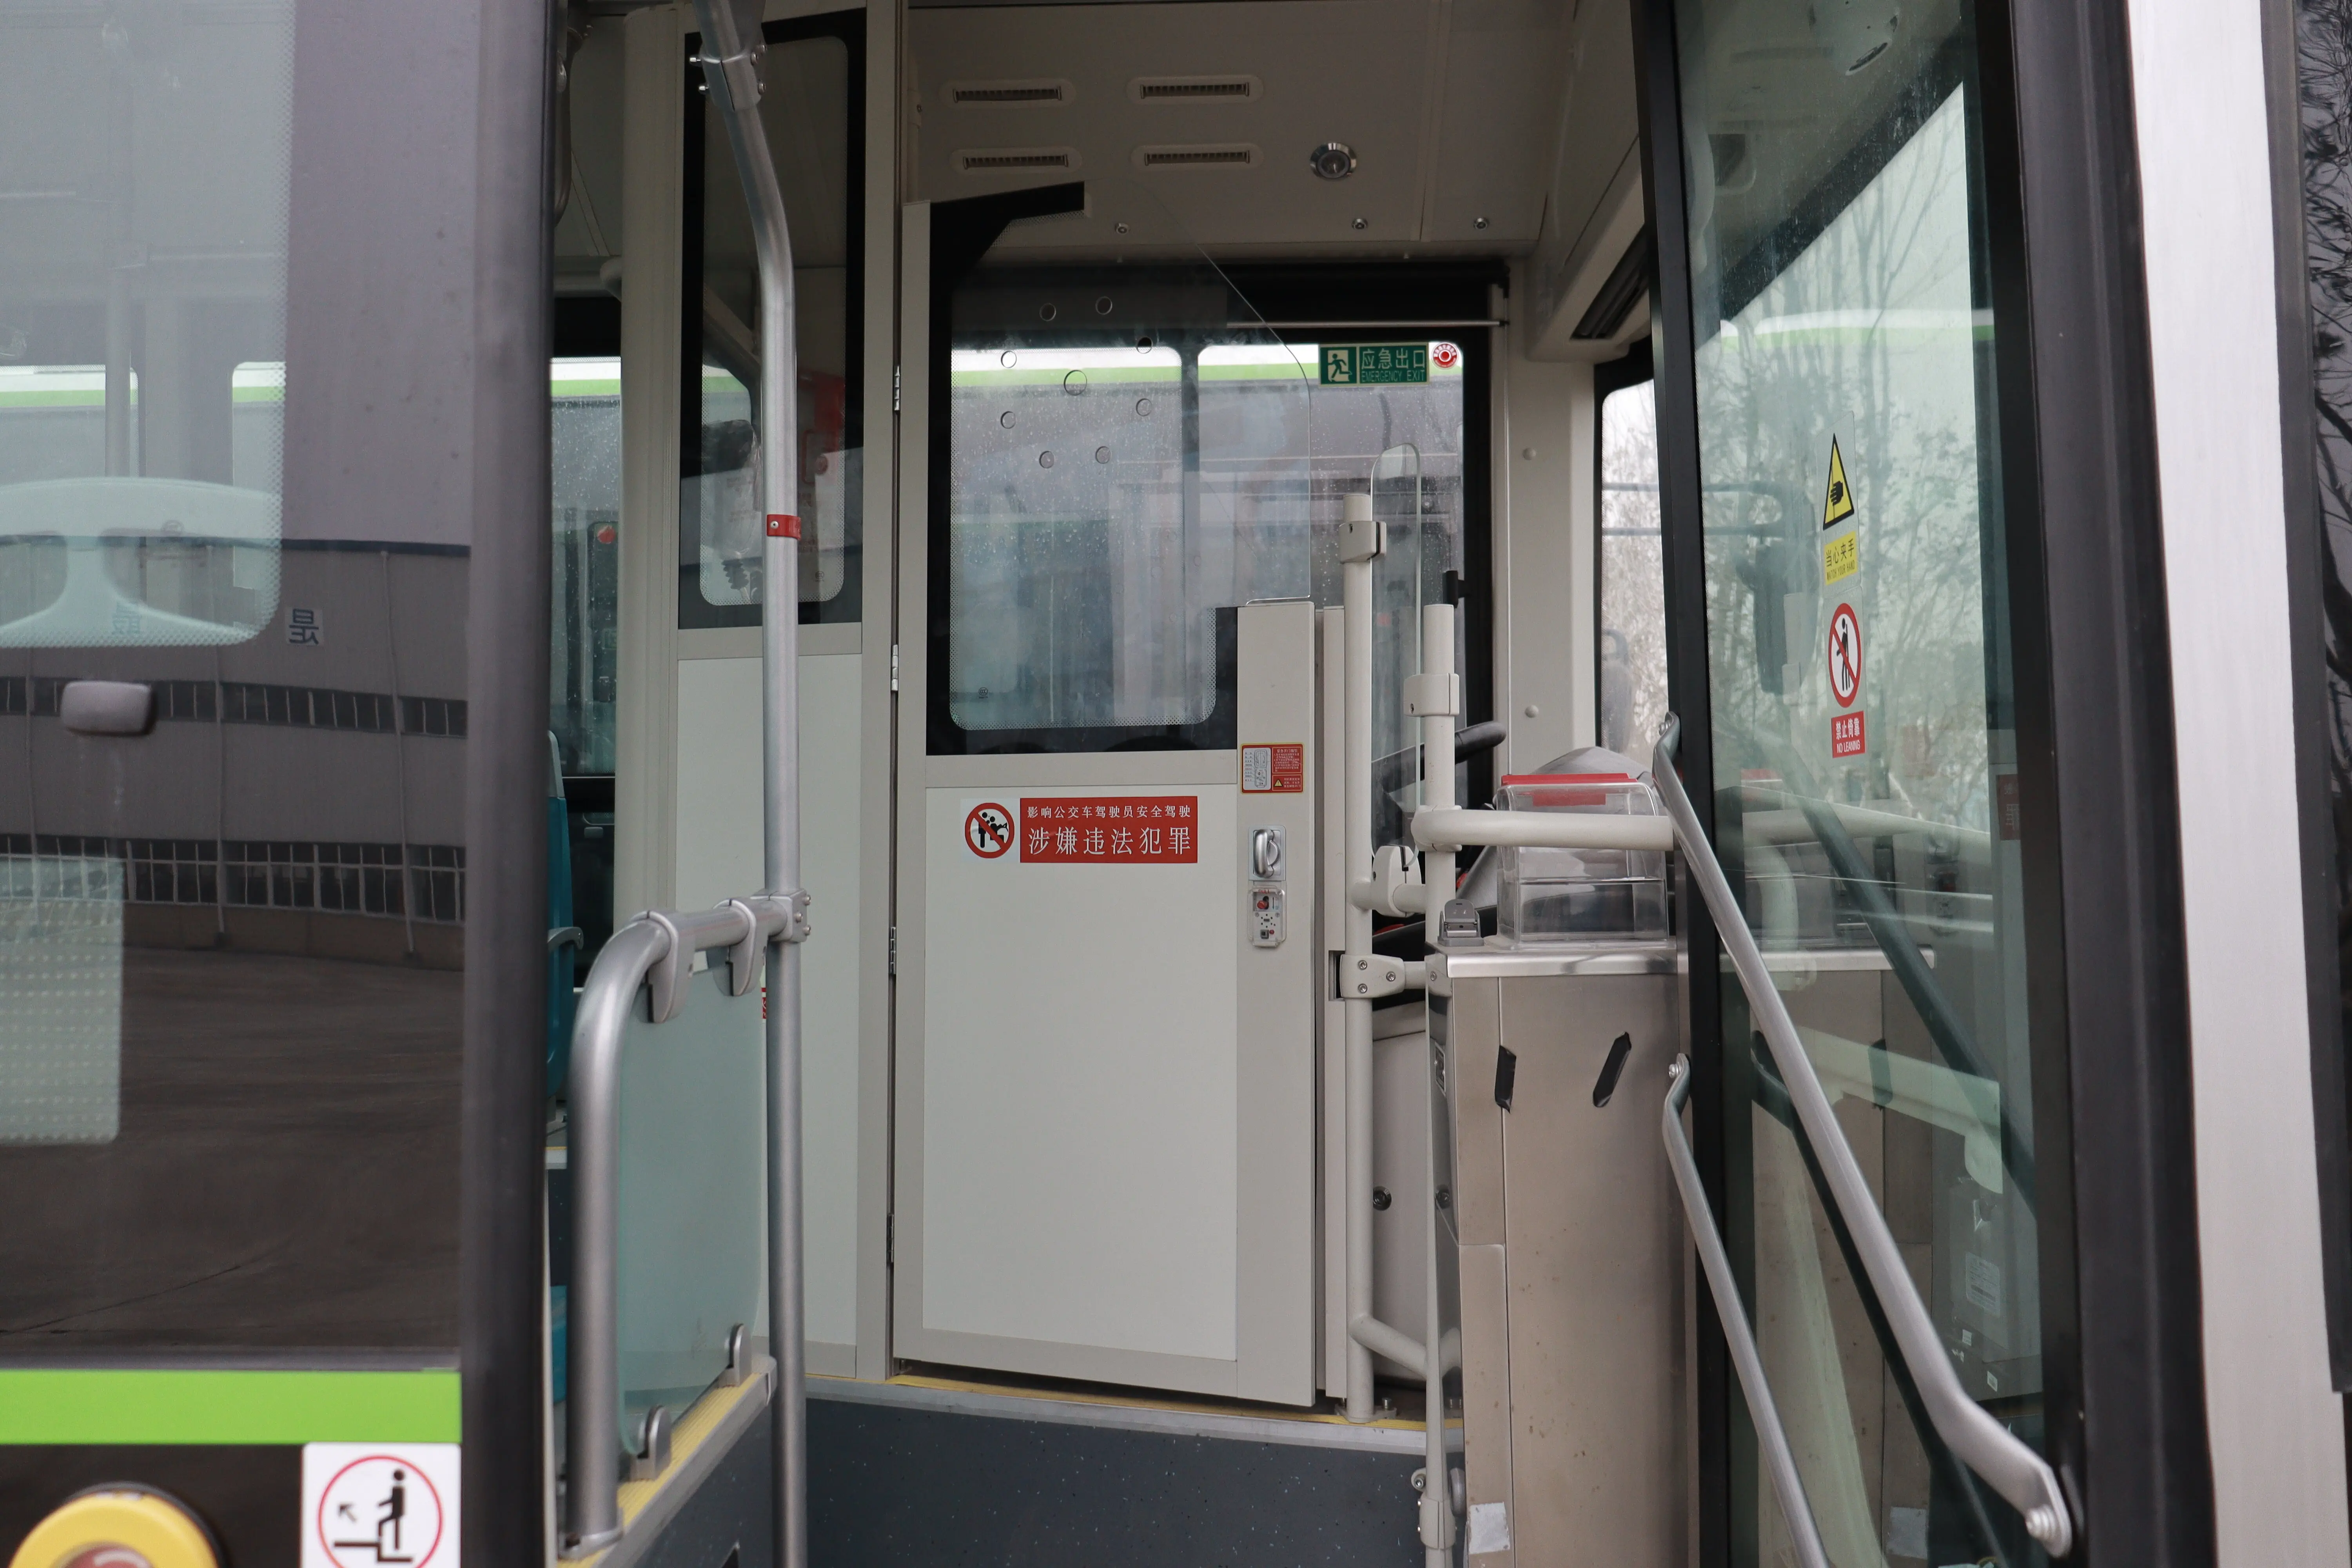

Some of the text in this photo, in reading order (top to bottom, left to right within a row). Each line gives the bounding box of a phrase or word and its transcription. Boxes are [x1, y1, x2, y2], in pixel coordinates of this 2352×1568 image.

[1361, 348, 1425, 369] 应急出口
[1361, 370, 1425, 383] EMERGENCY EXIT
[1826, 538, 1854, 568] 当心夹手
[1837, 564, 1846, 576] YOUR
[1846, 559, 1855, 572] HAND
[1836, 717, 1860, 740] 禁止倚靠
[1837, 740, 1861, 753] NO LEANING
[1027, 804, 1191, 818] 影响公交车驾驶员安全驾驶
[1028, 826, 1191, 855] 涉嫌违法犯罪
